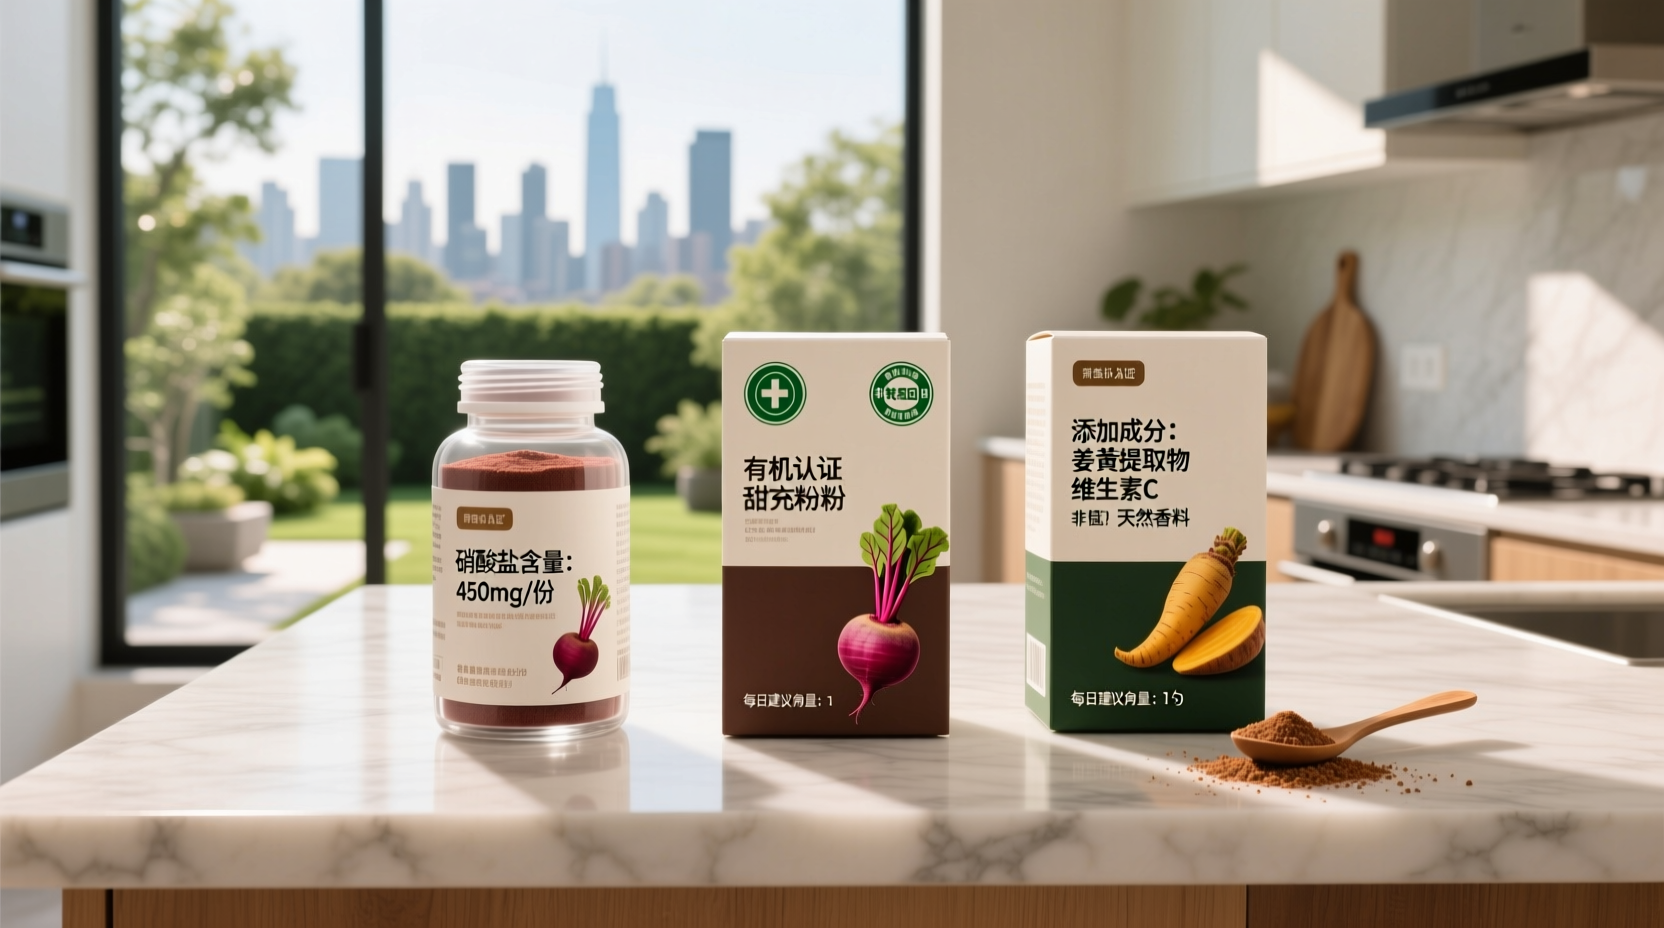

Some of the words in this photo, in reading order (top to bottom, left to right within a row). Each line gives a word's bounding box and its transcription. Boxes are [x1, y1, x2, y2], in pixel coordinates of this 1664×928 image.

[1071, 418, 1176, 443] 添加成分：
[743, 455, 843, 481] 有机认证
[1071, 447, 1190, 472] 姜黄提取物
[1071, 476, 1159, 501] 维生素C
[1117, 507, 1190, 528] 天然香料
[455, 548, 572, 574] 硝酸盐含量：
[456, 579, 555, 608] 450mg/份
